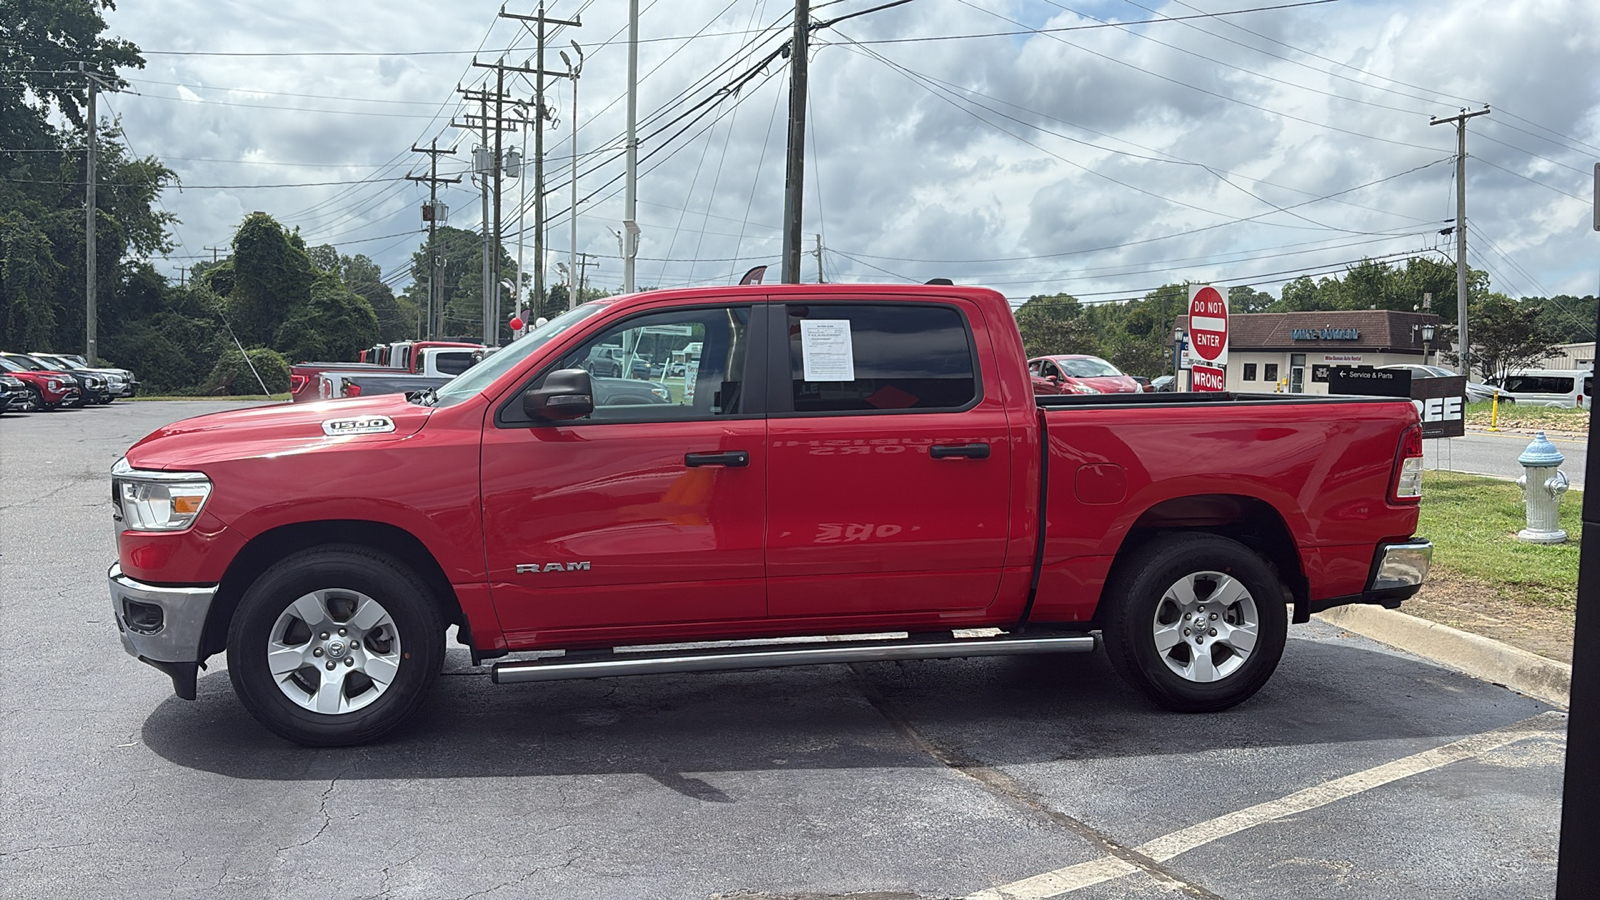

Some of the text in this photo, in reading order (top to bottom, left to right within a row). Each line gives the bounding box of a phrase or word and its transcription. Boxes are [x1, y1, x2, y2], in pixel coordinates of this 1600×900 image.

[1194, 301, 1222, 314] DO NOT
[1197, 333, 1220, 347] ENTER
[1193, 371, 1223, 390] WRONG
[1349, 370, 1371, 379] Service
[1412, 397, 1462, 422] REE
[331, 419, 385, 430] 1500
[515, 561, 591, 573] RAM
